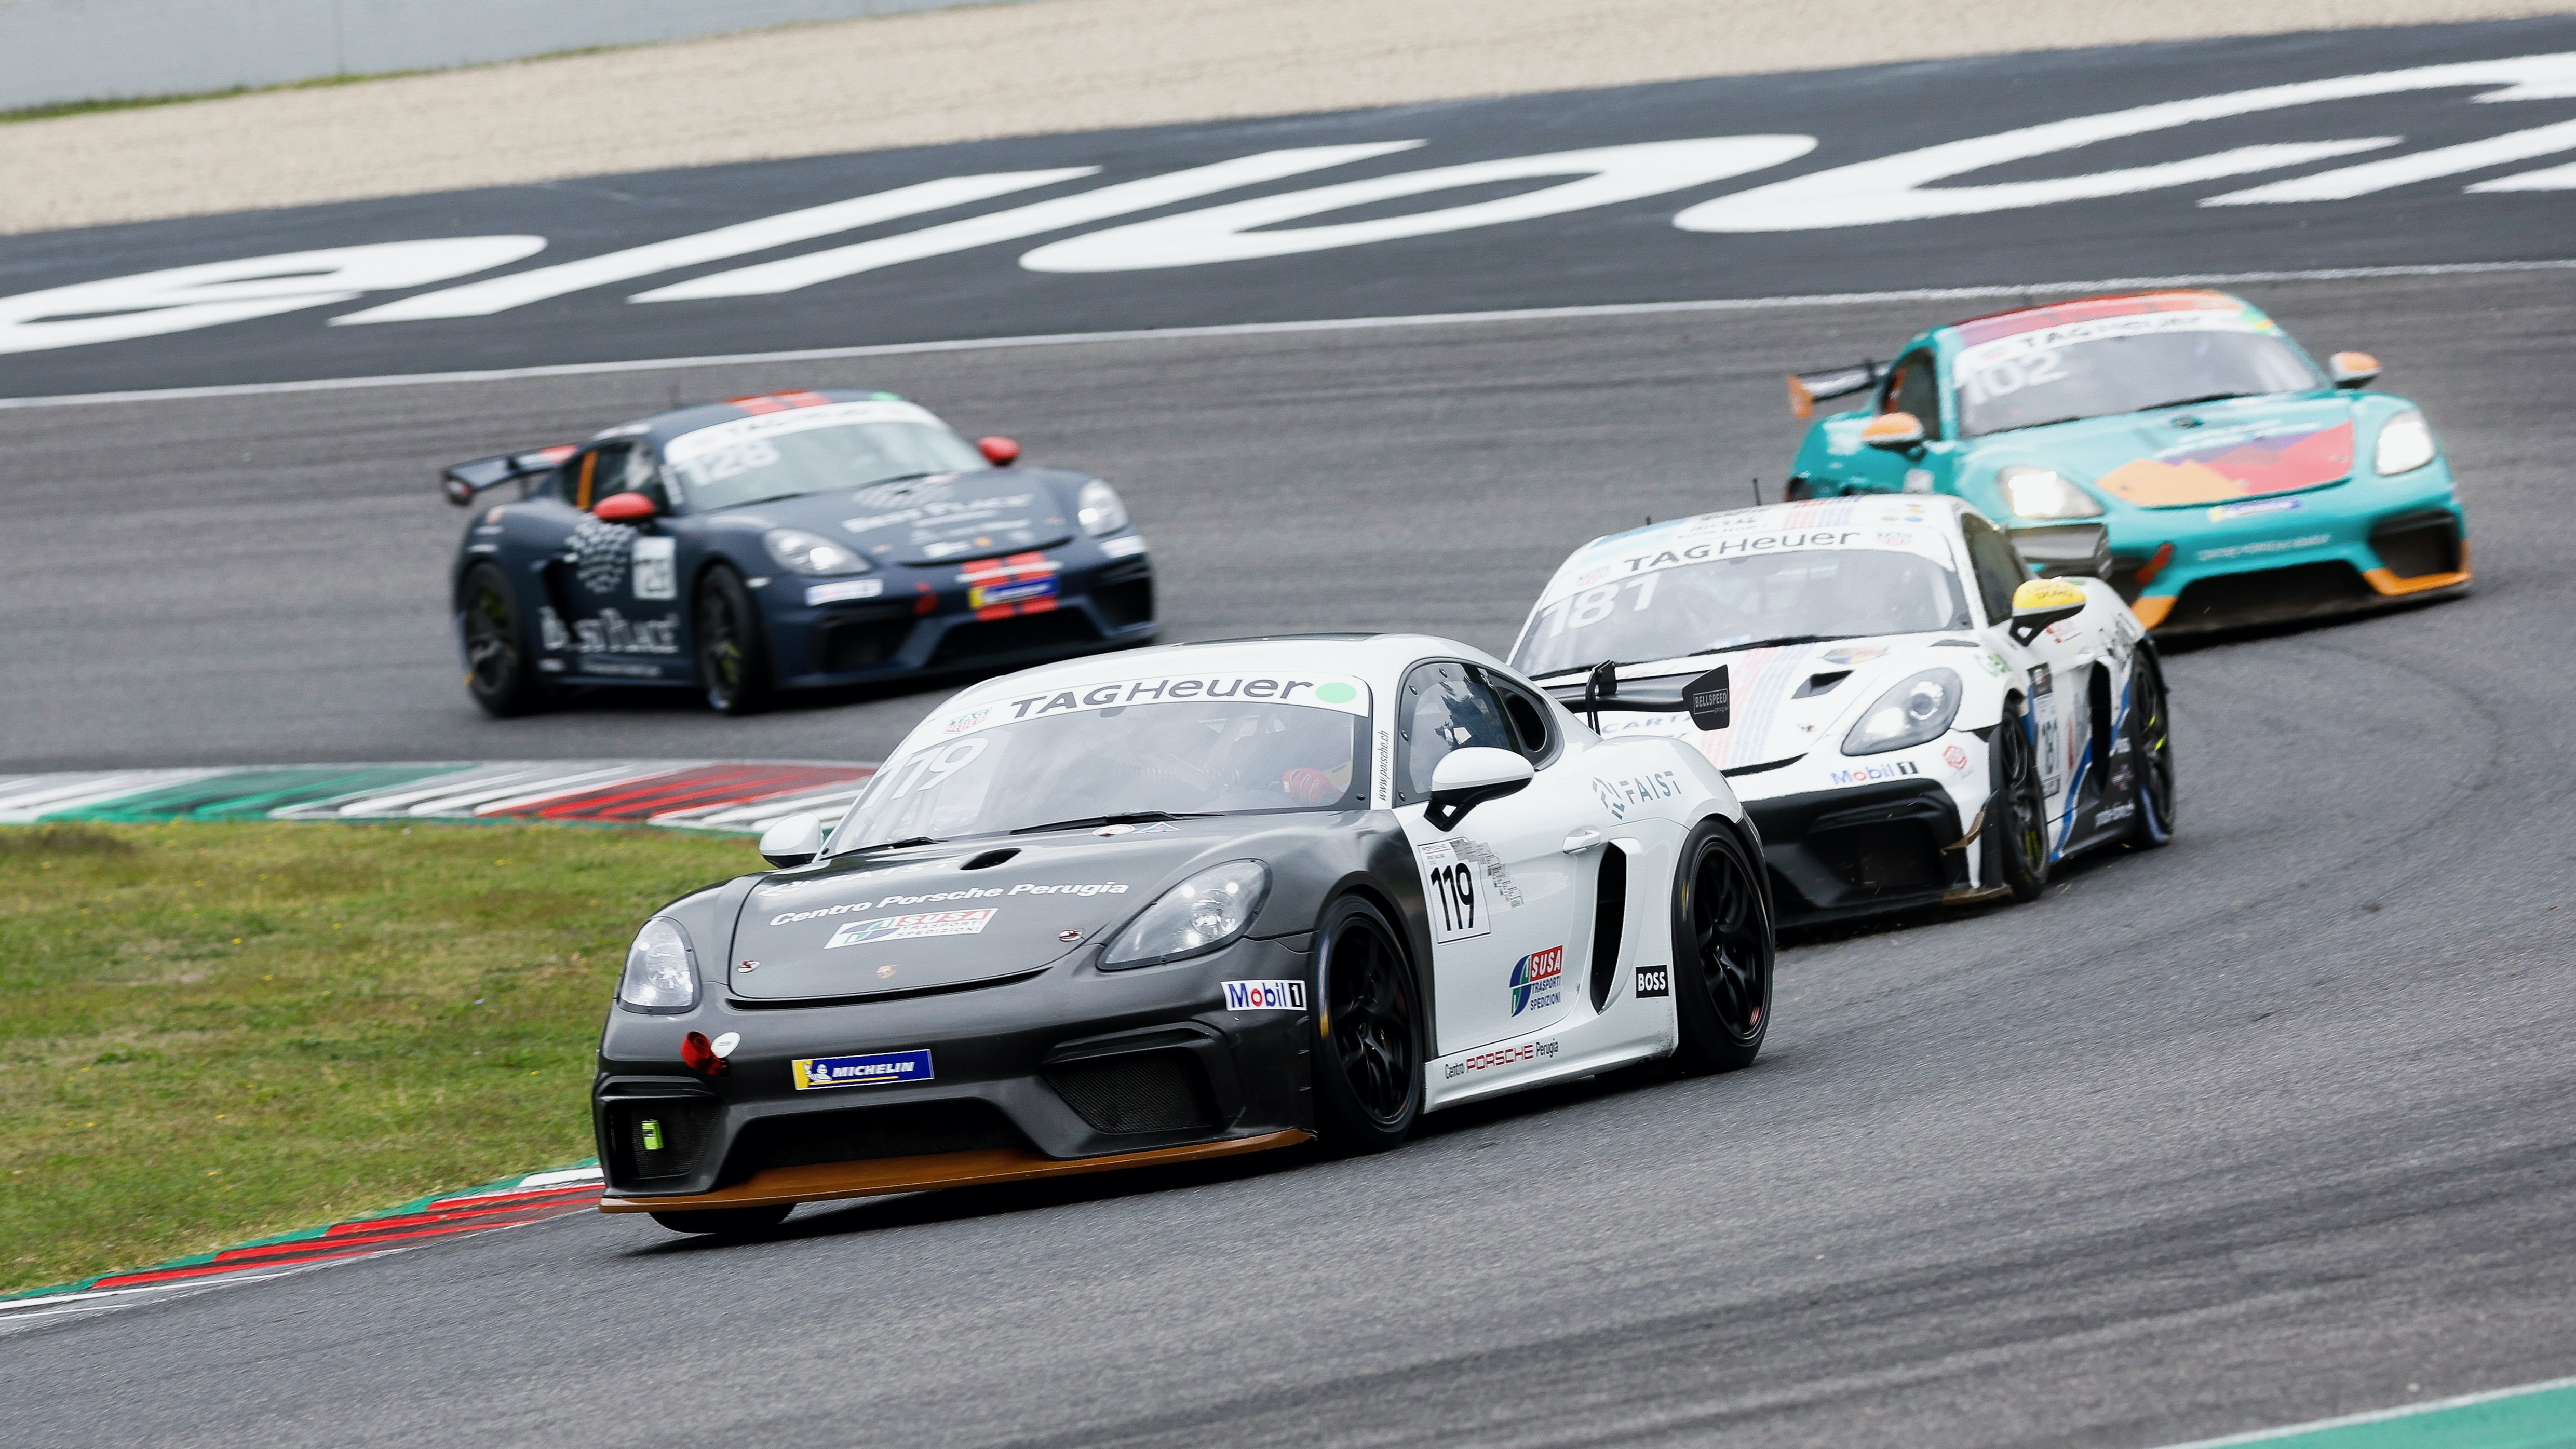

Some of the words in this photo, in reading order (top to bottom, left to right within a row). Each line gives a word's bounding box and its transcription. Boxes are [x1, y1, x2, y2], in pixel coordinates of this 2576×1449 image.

[1963, 351, 2067, 403] 102
[1542, 572, 1661, 638] 181
[1695, 692, 1727, 708] BELLSPEED
[861, 737, 989, 810] 119
[1378, 730, 1390, 801] www.porsche.ch
[1831, 764, 1894, 784] Mobil
[1625, 771, 1683, 805] FAIST
[770, 901, 873, 926] Centro
[876, 886, 1005, 909] Porsche
[1007, 881, 1129, 897] Perugia
[1431, 863, 1475, 932] 119
[900, 911, 987, 926] SUSA
[1532, 950, 1561, 978] SUSA
[1227, 982, 1287, 1007] Mobil
[1532, 976, 1561, 994] TRASPORTI
[1638, 972, 1666, 991] BOSS
[1530, 992, 1561, 1010] SPEDIZIONI
[832, 1062, 915, 1077] MICHELIN
[1445, 1063, 1465, 1079] Centro
[1466, 1045, 1533, 1073] PORSCHE
[1536, 1038, 1558, 1058] Perugia
